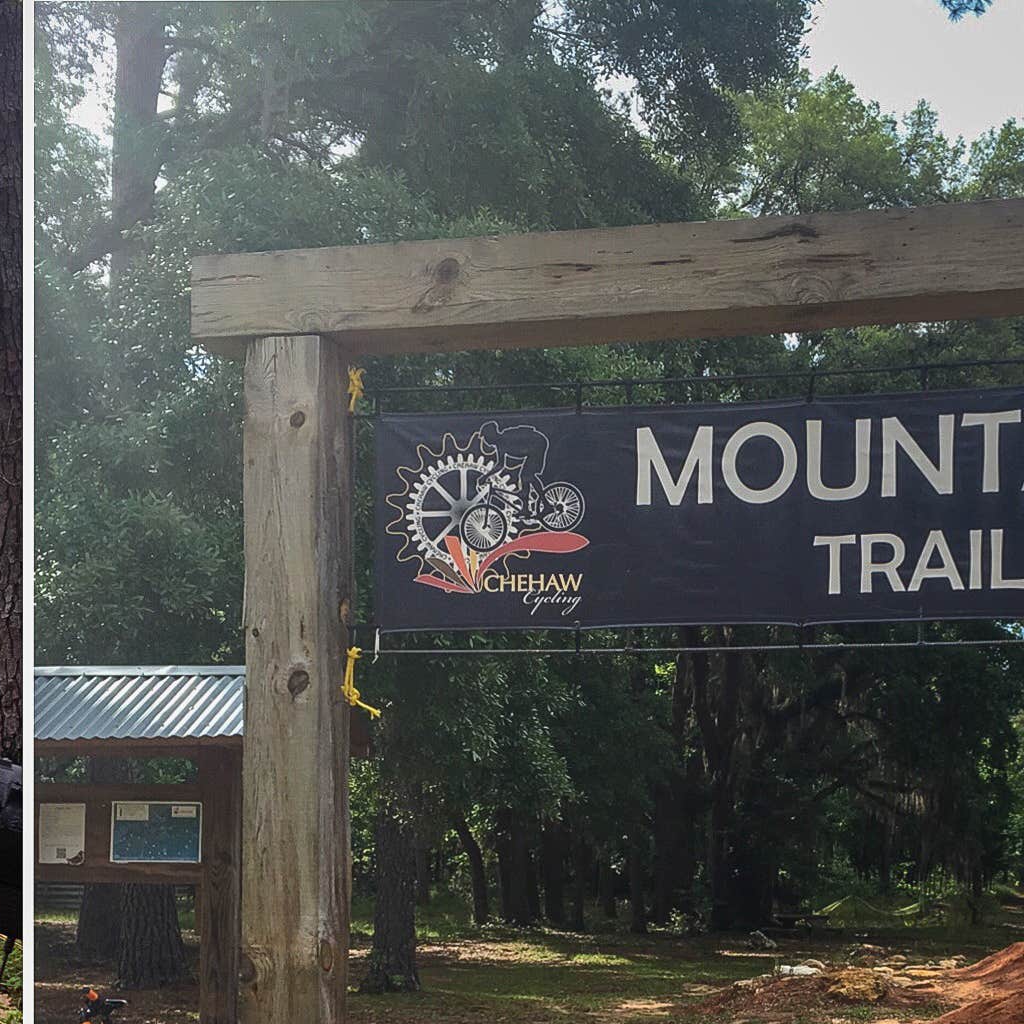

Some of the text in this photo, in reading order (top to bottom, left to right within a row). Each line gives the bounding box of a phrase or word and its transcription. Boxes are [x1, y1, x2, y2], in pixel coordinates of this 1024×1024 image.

[636, 409, 1024, 506] MOUNT
[484, 573, 583, 592] CHEHAW
[813, 529, 1024, 595] TRAIL
[523, 588, 581, 616] Cycling
